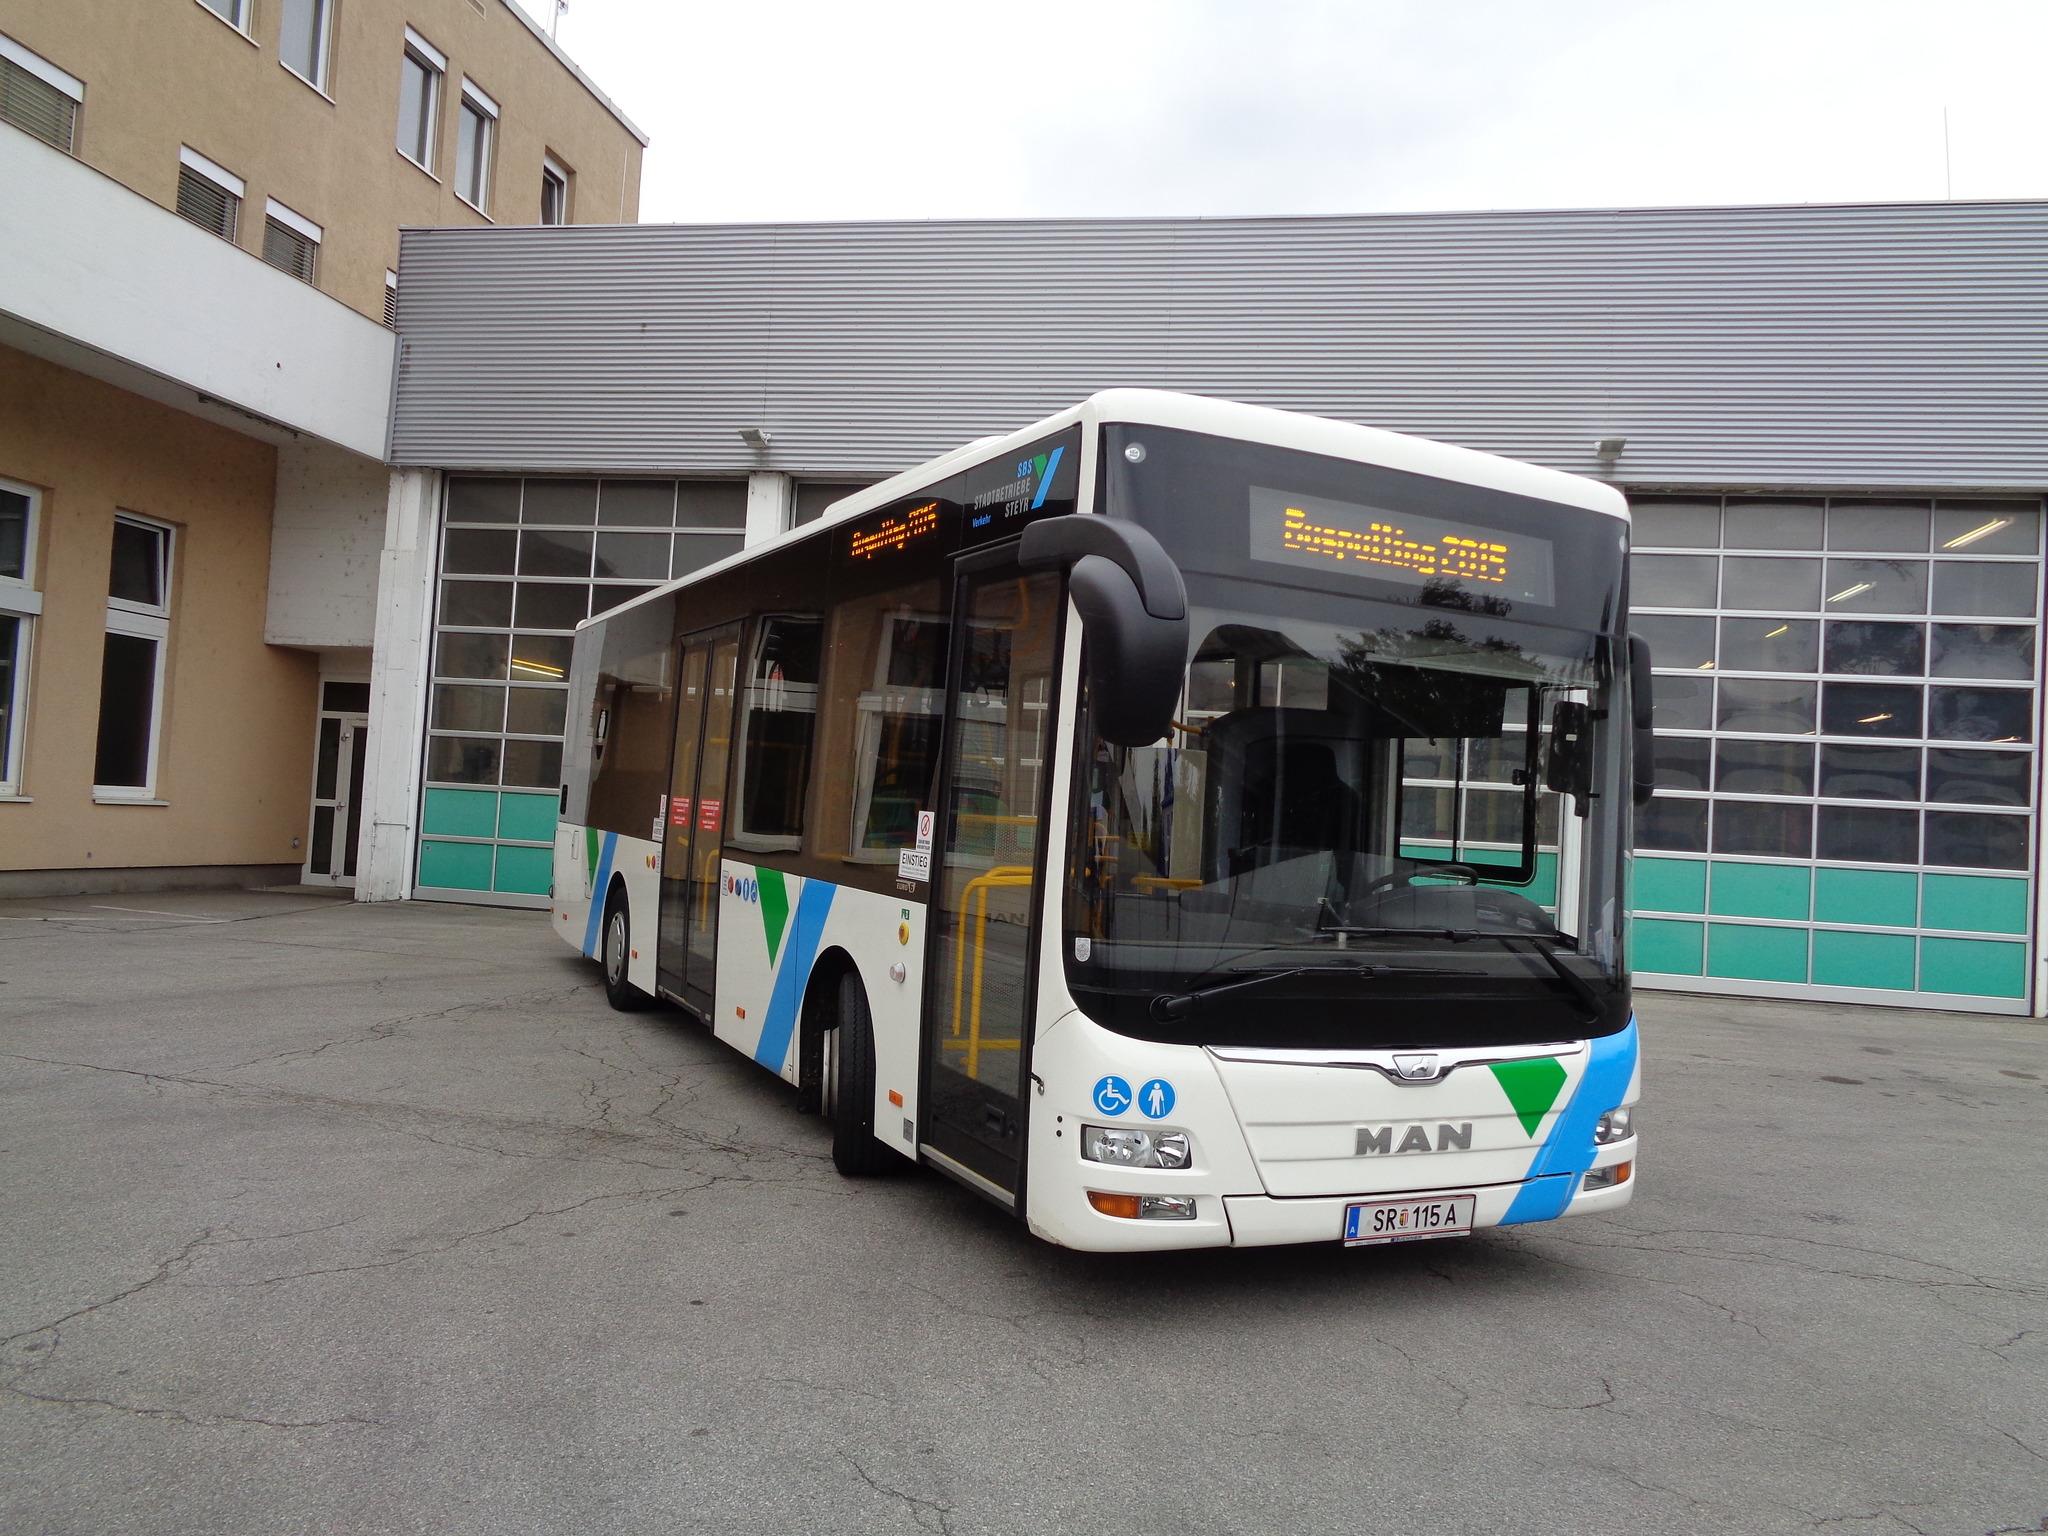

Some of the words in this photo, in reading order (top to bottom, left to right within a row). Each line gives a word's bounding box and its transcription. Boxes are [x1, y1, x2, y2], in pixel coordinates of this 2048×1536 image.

[1017, 458, 1033, 478] SBS
[974, 477, 1031, 511] STADTBETRIEBE
[1004, 496, 1029, 518] STEYR
[972, 513, 992, 529] Verkehr
[902, 853, 928, 868] EINSTIEG
[1354, 1121, 1473, 1156] MAN
[1373, 1208, 1398, 1232] SR
[1412, 1204, 1441, 1228] 115
[1444, 1203, 1457, 1226] A
